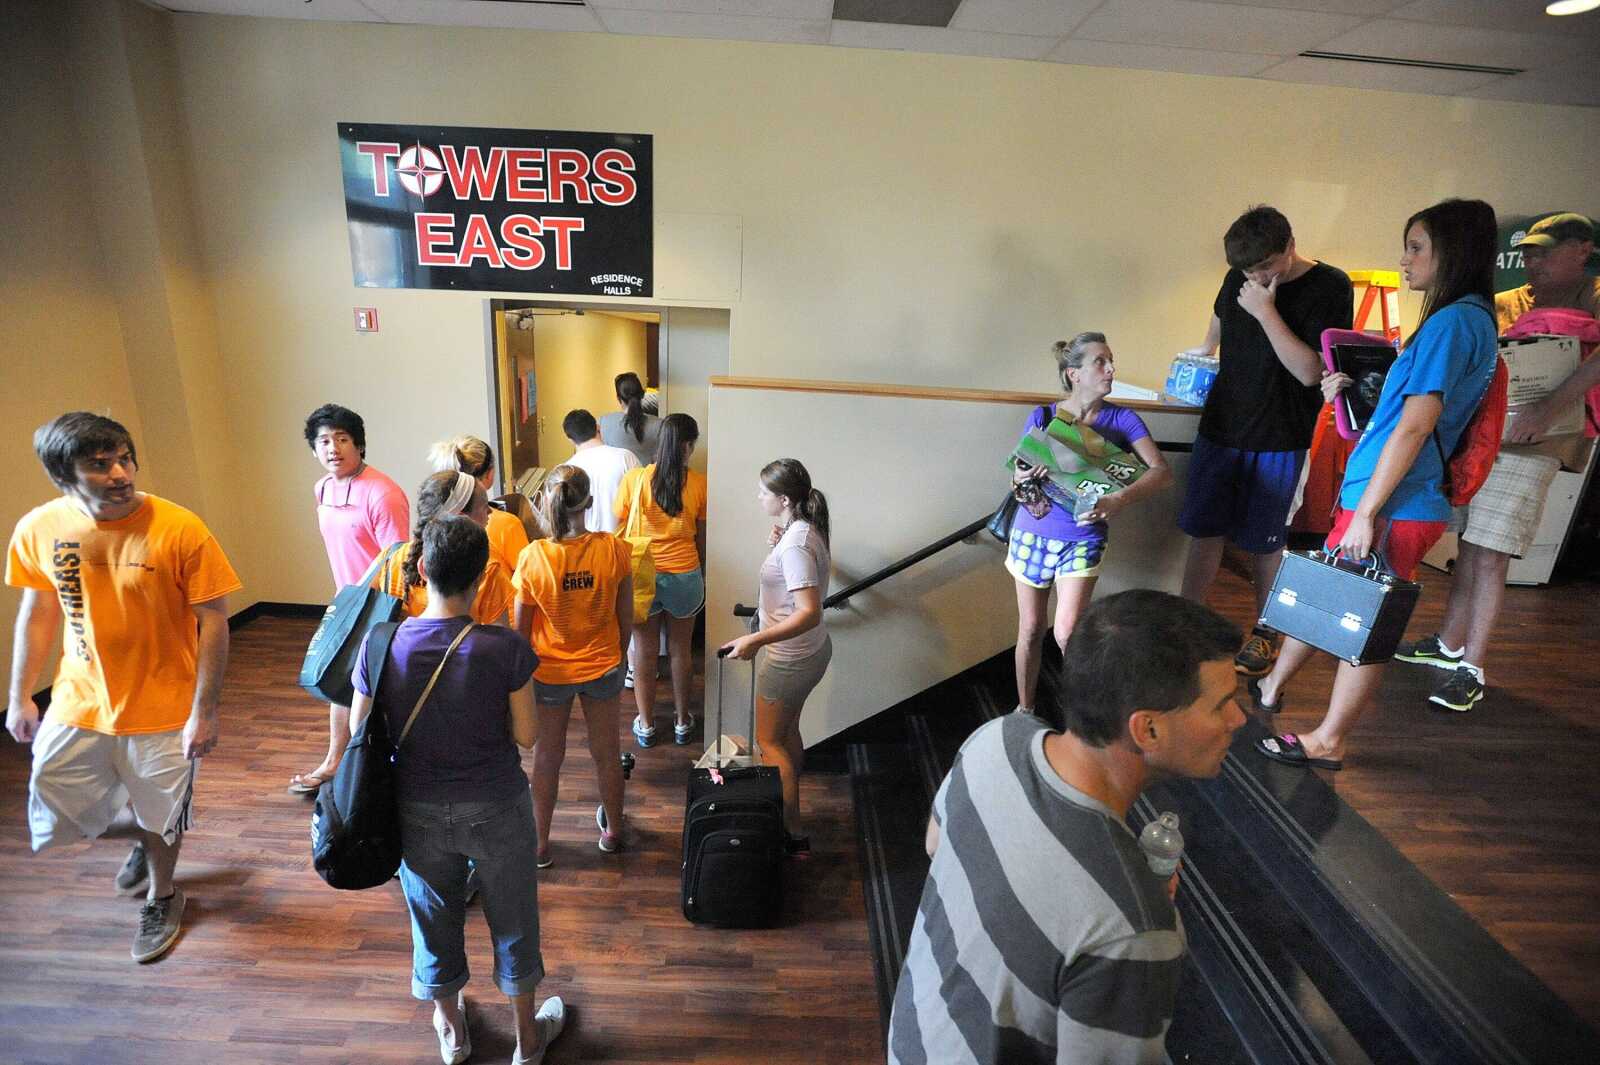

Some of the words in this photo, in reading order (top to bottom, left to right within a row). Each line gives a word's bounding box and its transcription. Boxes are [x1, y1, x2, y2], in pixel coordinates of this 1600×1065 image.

[356, 139, 637, 206] TOWERS
[414, 212, 585, 271] EAST
[590, 273, 643, 287] RESIDENCE
[603, 285, 632, 296] HALLS
[562, 574, 594, 592] CREW
